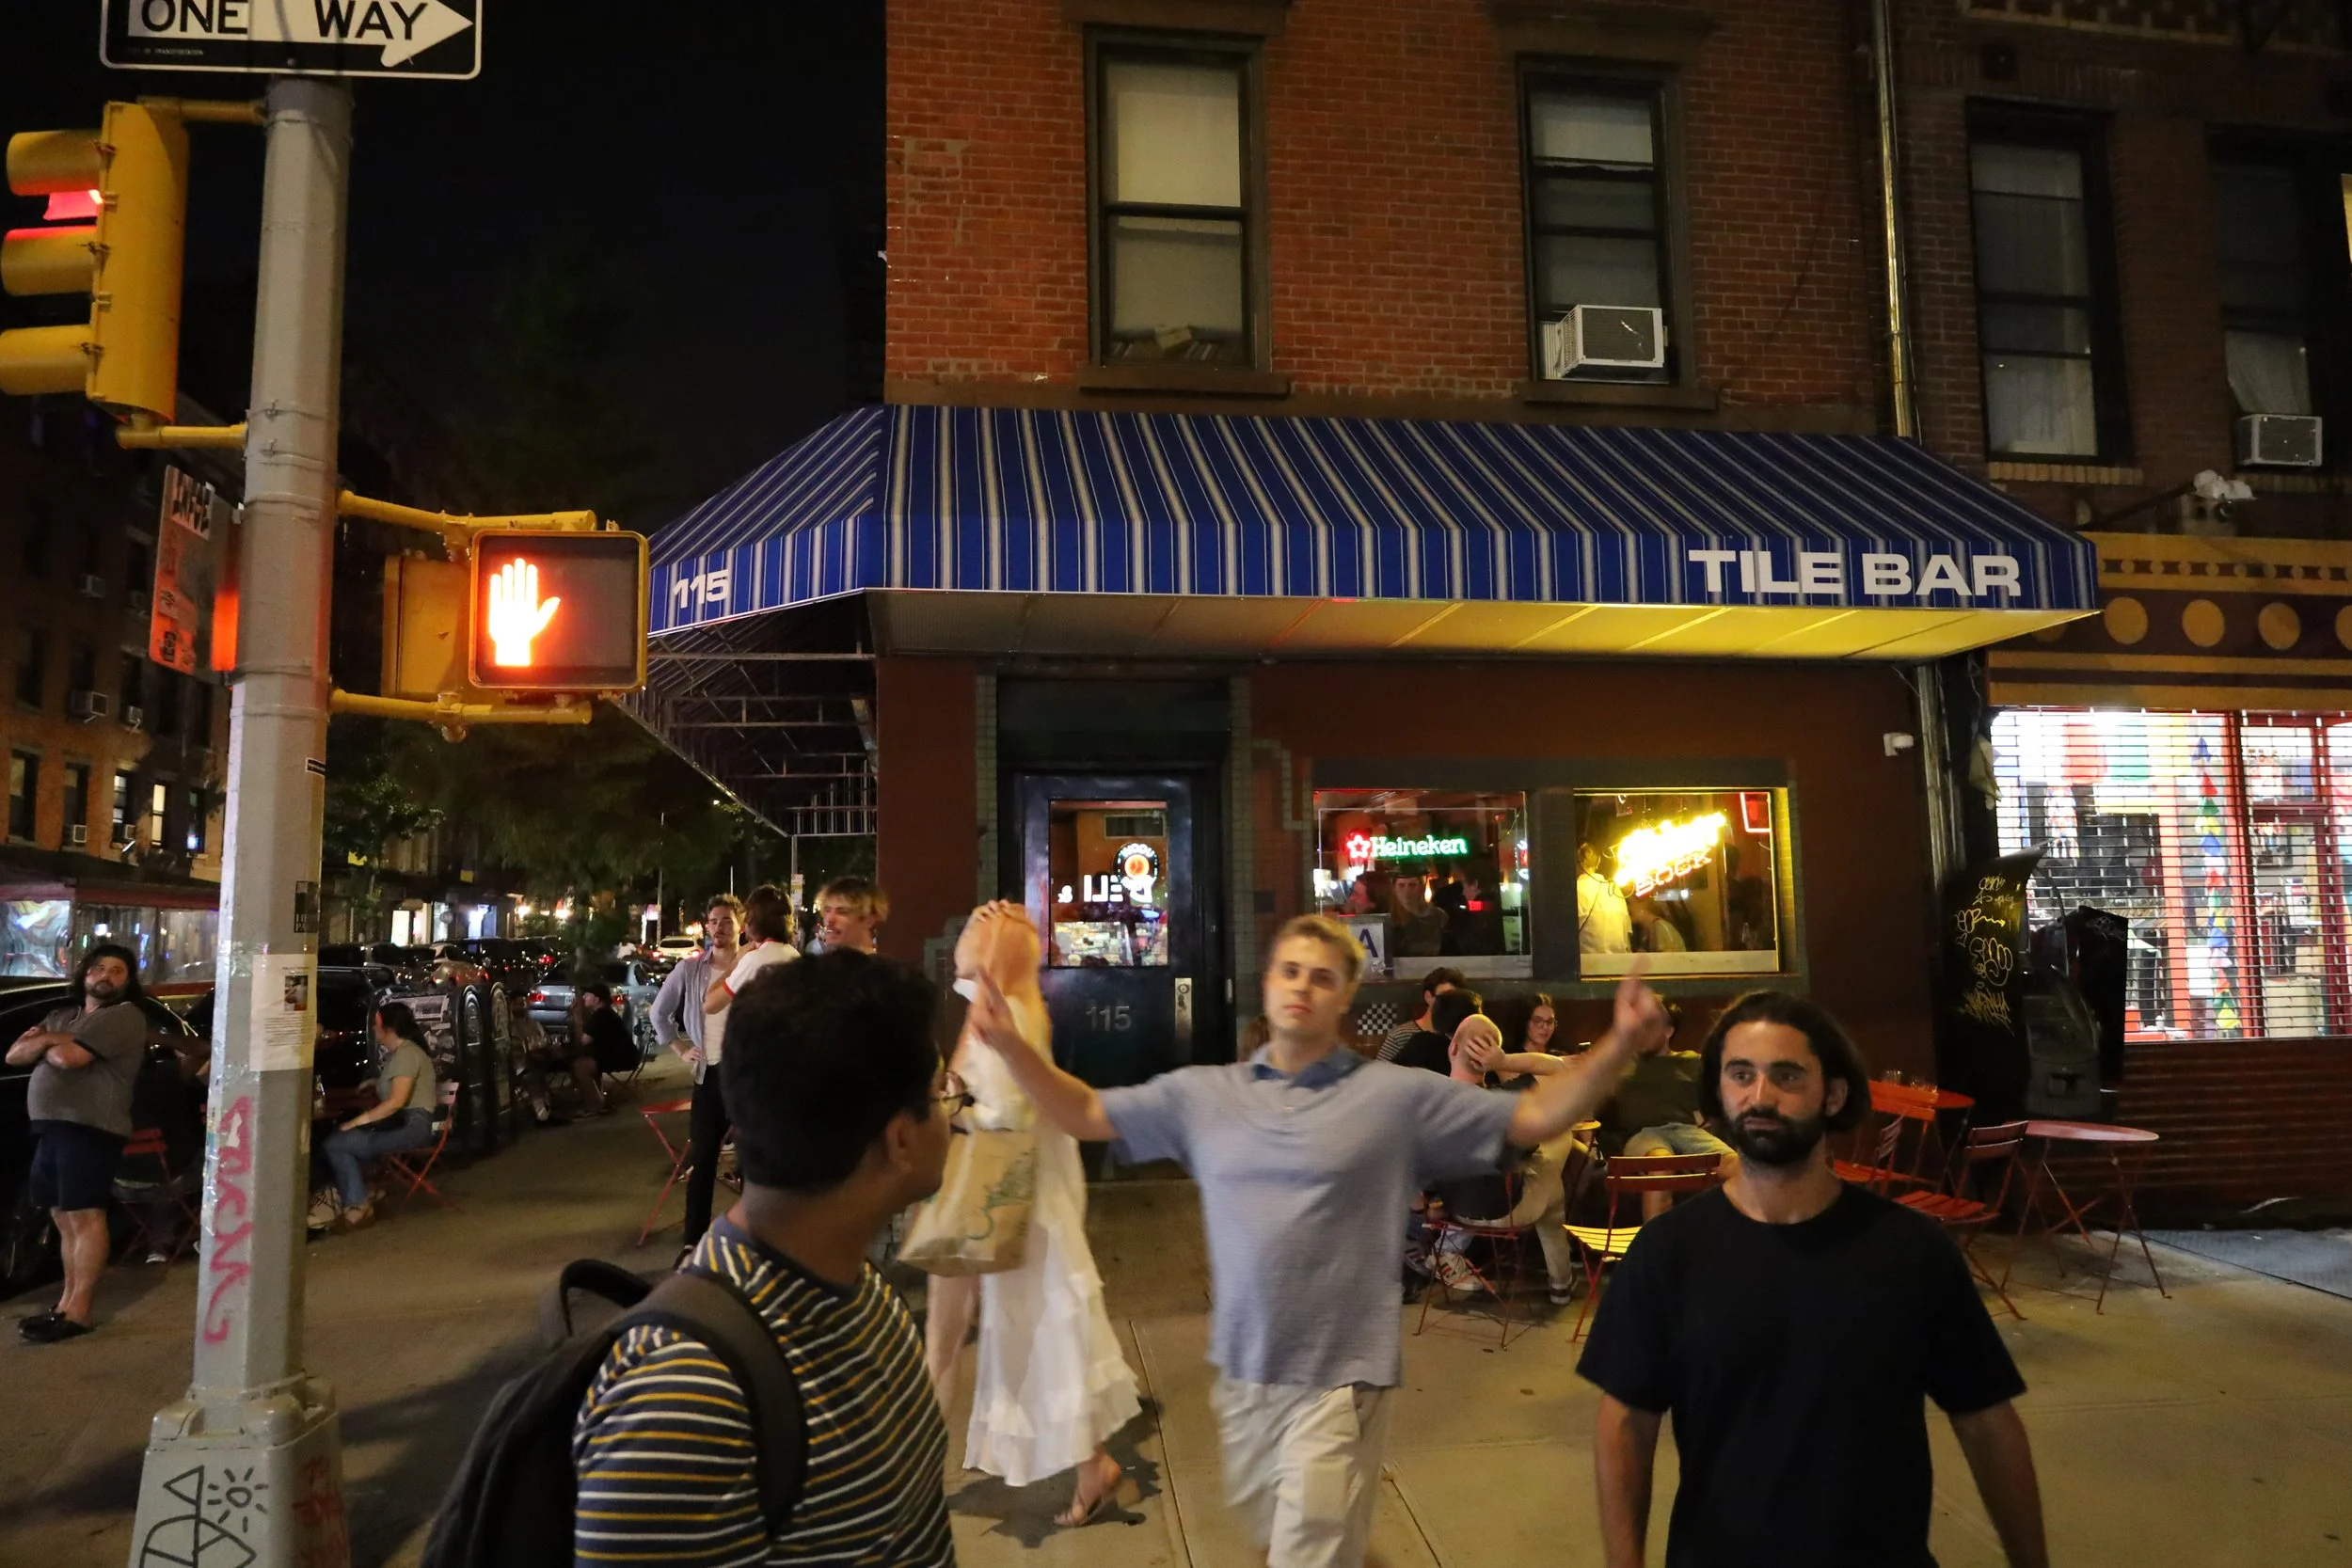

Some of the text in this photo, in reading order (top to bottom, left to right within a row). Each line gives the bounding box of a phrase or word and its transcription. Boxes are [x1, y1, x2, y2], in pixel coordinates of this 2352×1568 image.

[141, 0, 428, 40] ONE WAY
[673, 569, 729, 609] 115
[1688, 550, 2022, 596] TILE BAR
[1370, 835, 1468, 858] Heineken
[1635, 847, 1712, 897] BOCK
[1359, 928, 1379, 958] A
[1085, 1006, 1133, 1032] 115
